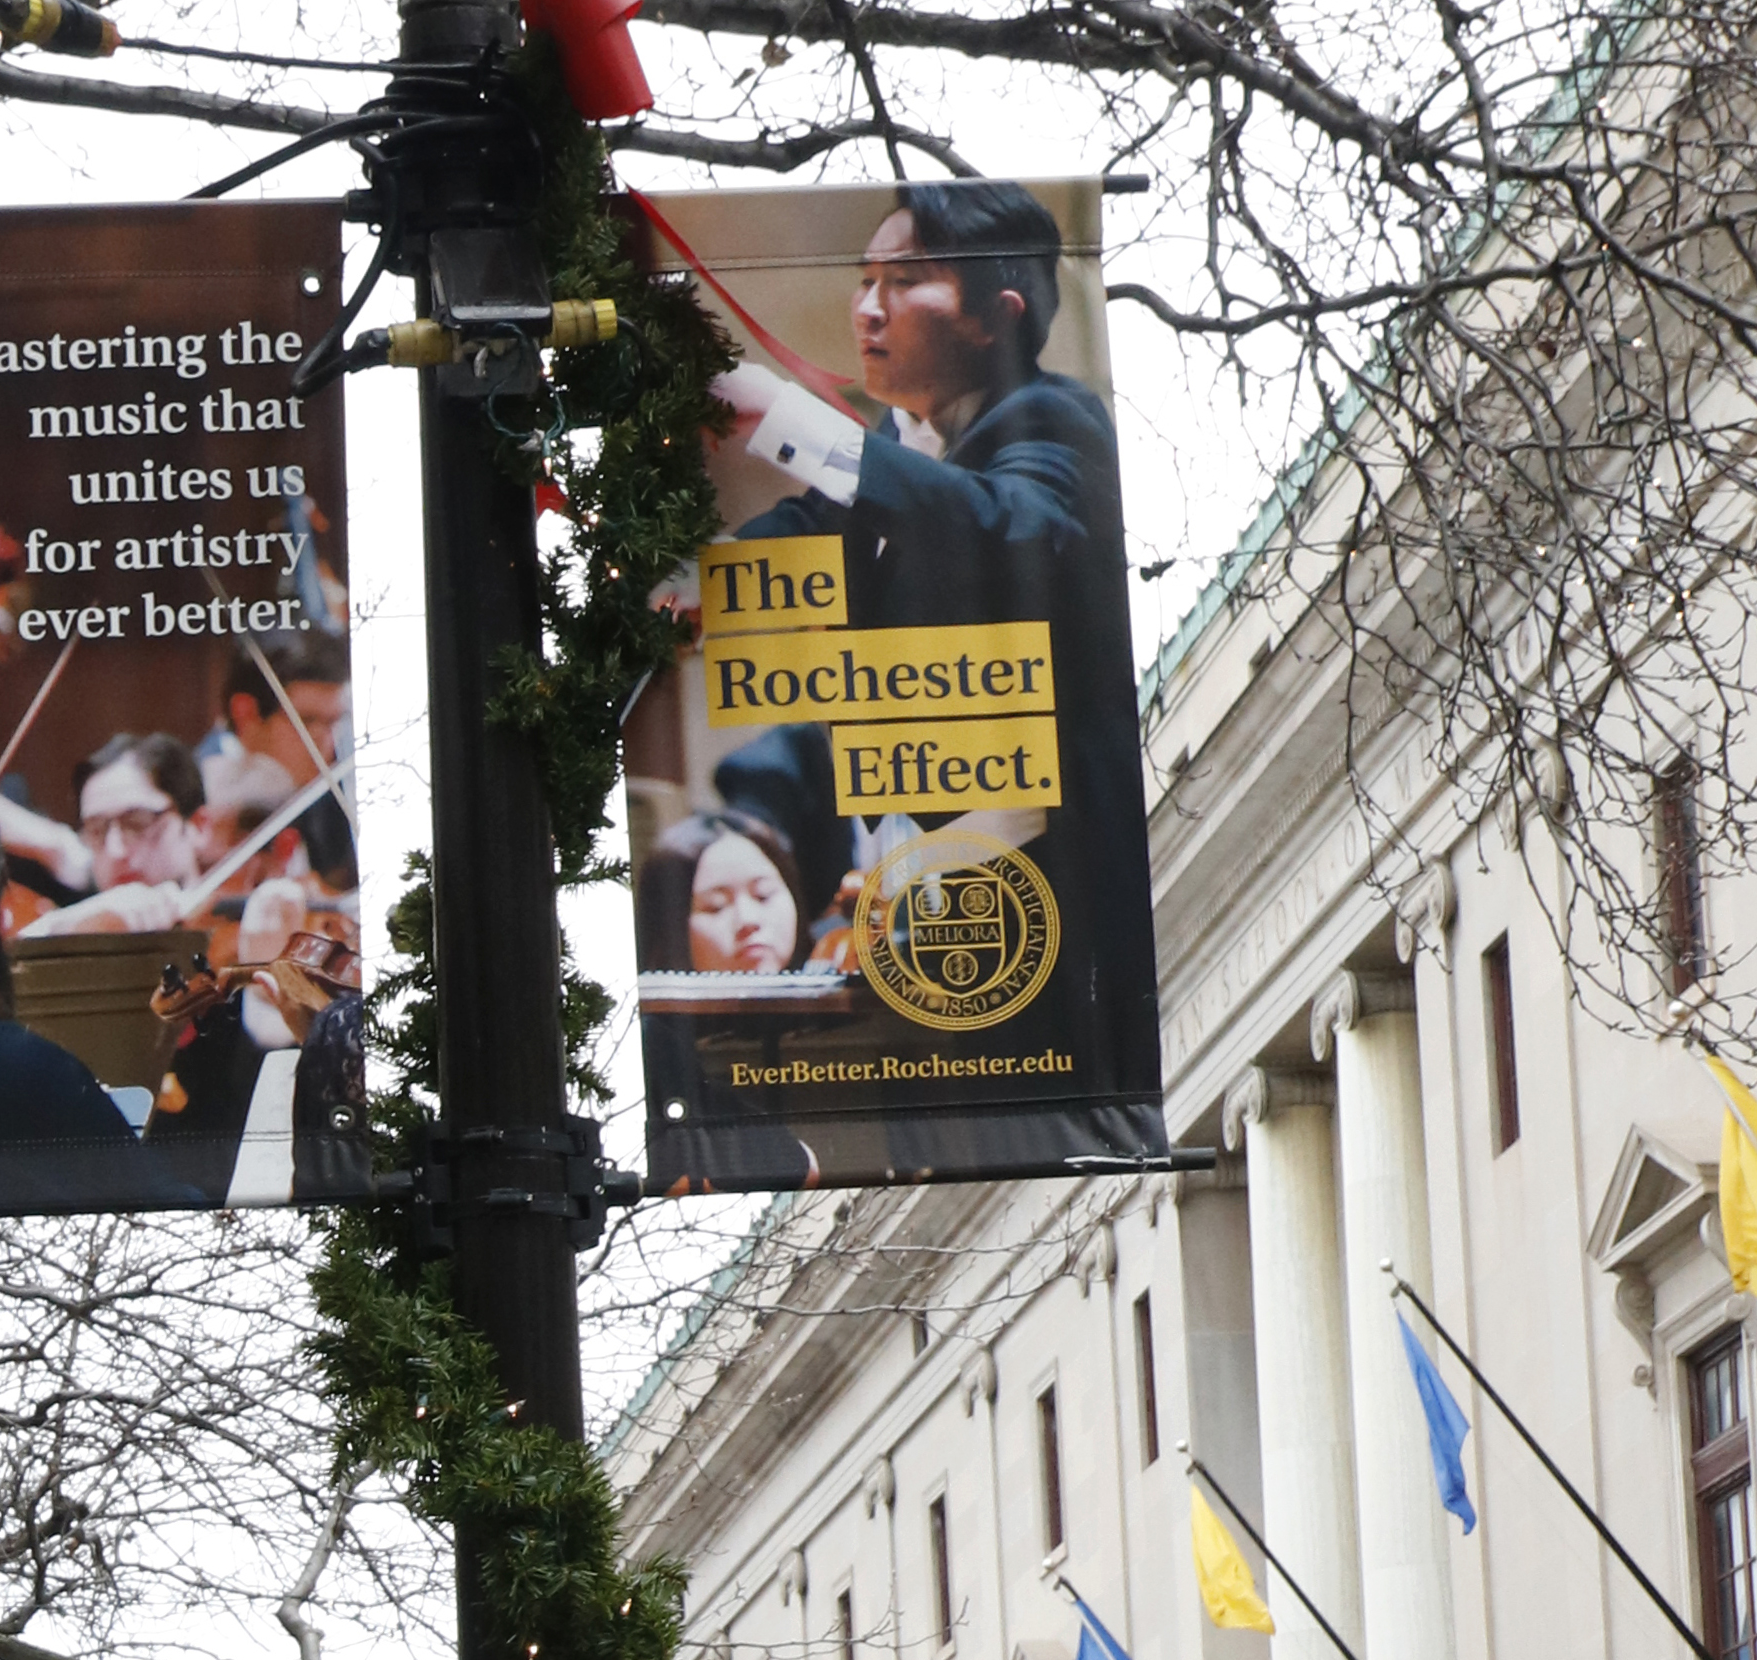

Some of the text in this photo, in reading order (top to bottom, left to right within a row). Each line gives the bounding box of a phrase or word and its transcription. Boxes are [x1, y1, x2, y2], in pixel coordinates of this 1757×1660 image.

[219, 321, 303, 367] the
[28, 387, 305, 438] music that
[68, 459, 305, 504] unites us
[24, 524, 309, 576] for artistry
[708, 558, 836, 615] The
[18, 592, 311, 642] ever better.
[714, 649, 1045, 711] Rochester
[844, 740, 1053, 798] Effect.
[915, 925, 1000, 944] MELIORA
[1007, 869, 1045, 953] OFFICIAL
[1222, 860, 1325, 1009] SCHOOL
[999, 958, 1038, 998] SEAL
[941, 994, 988, 1017] 1850
[731, 1049, 1074, 1087] EverBetter.Rochester.edu
